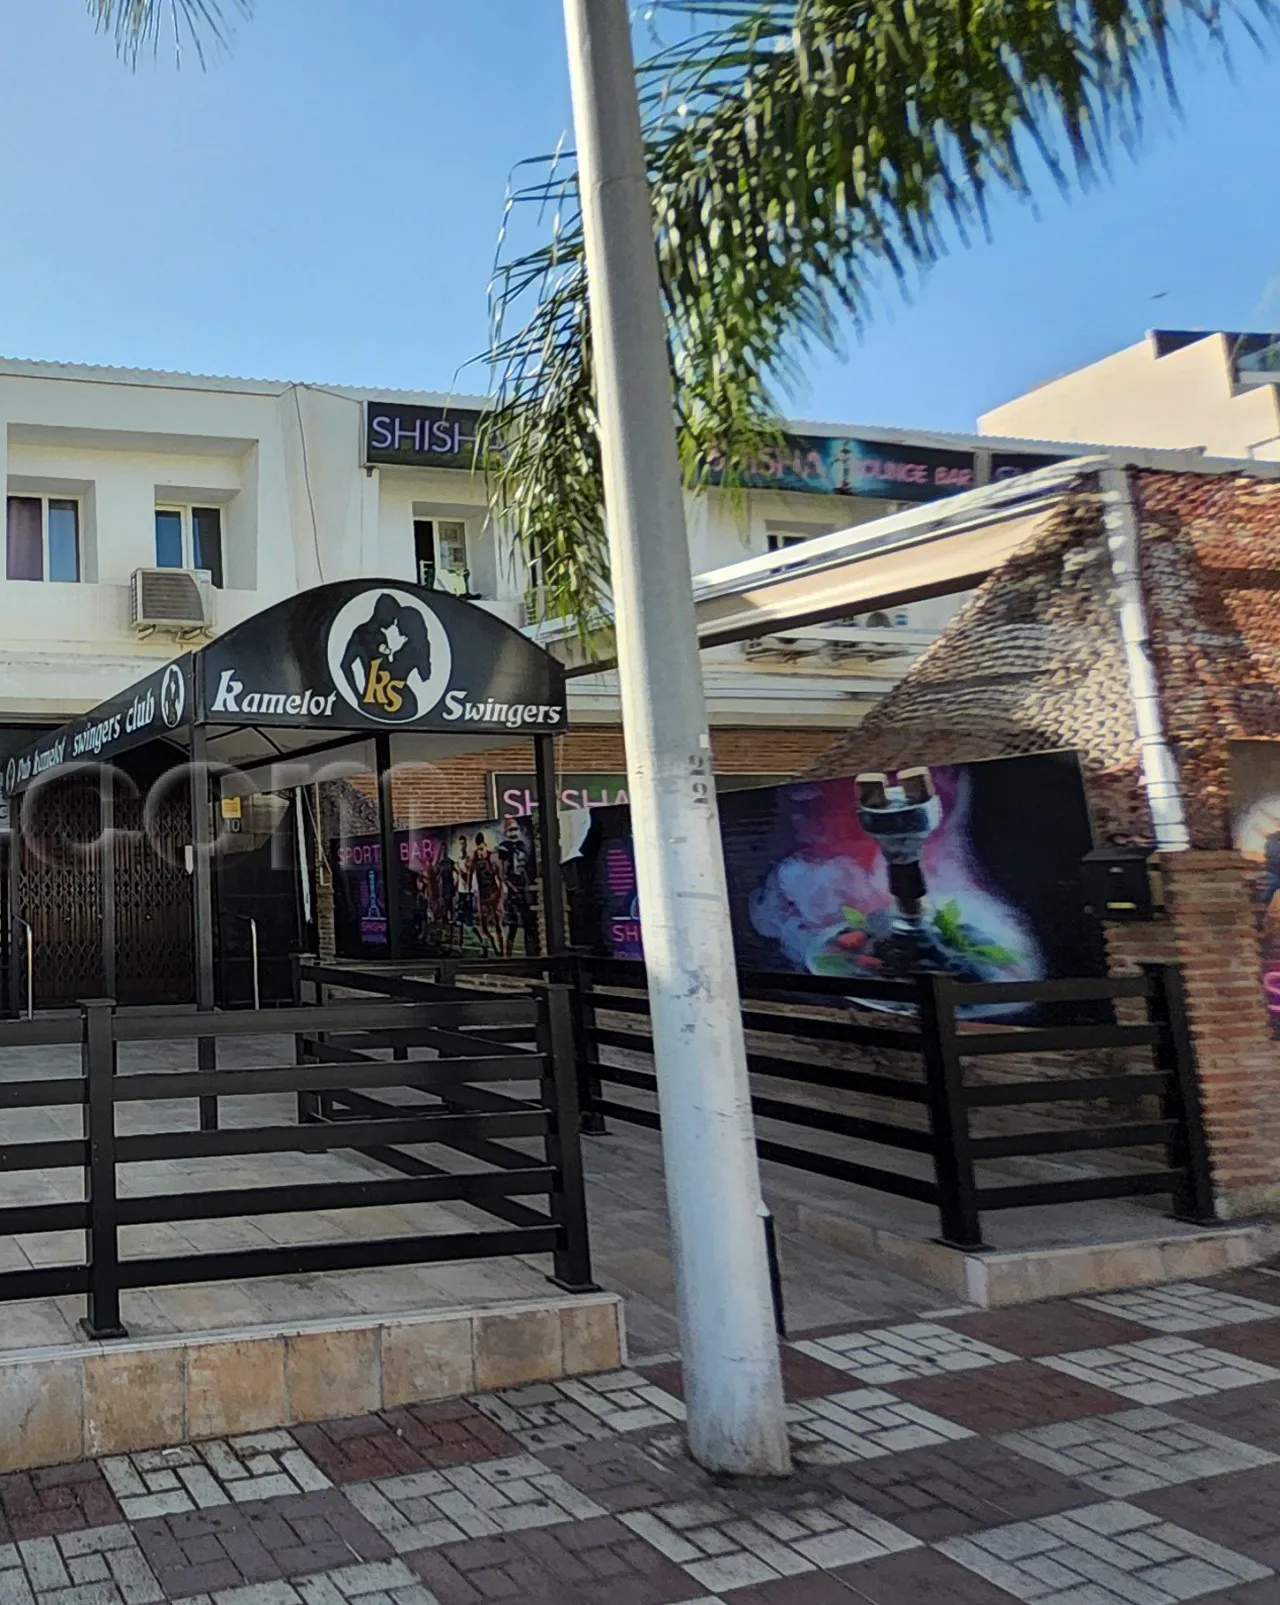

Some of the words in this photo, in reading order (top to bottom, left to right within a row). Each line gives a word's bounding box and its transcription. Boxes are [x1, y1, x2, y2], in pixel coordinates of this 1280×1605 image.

[934, 466, 973, 486] BAR
[72, 713, 122, 757] swingers
[125, 688, 156, 734] club
[442, 690, 562, 728] Swingers
[337, 844, 383, 866] SPORT
[400, 839, 434, 861] BAR
